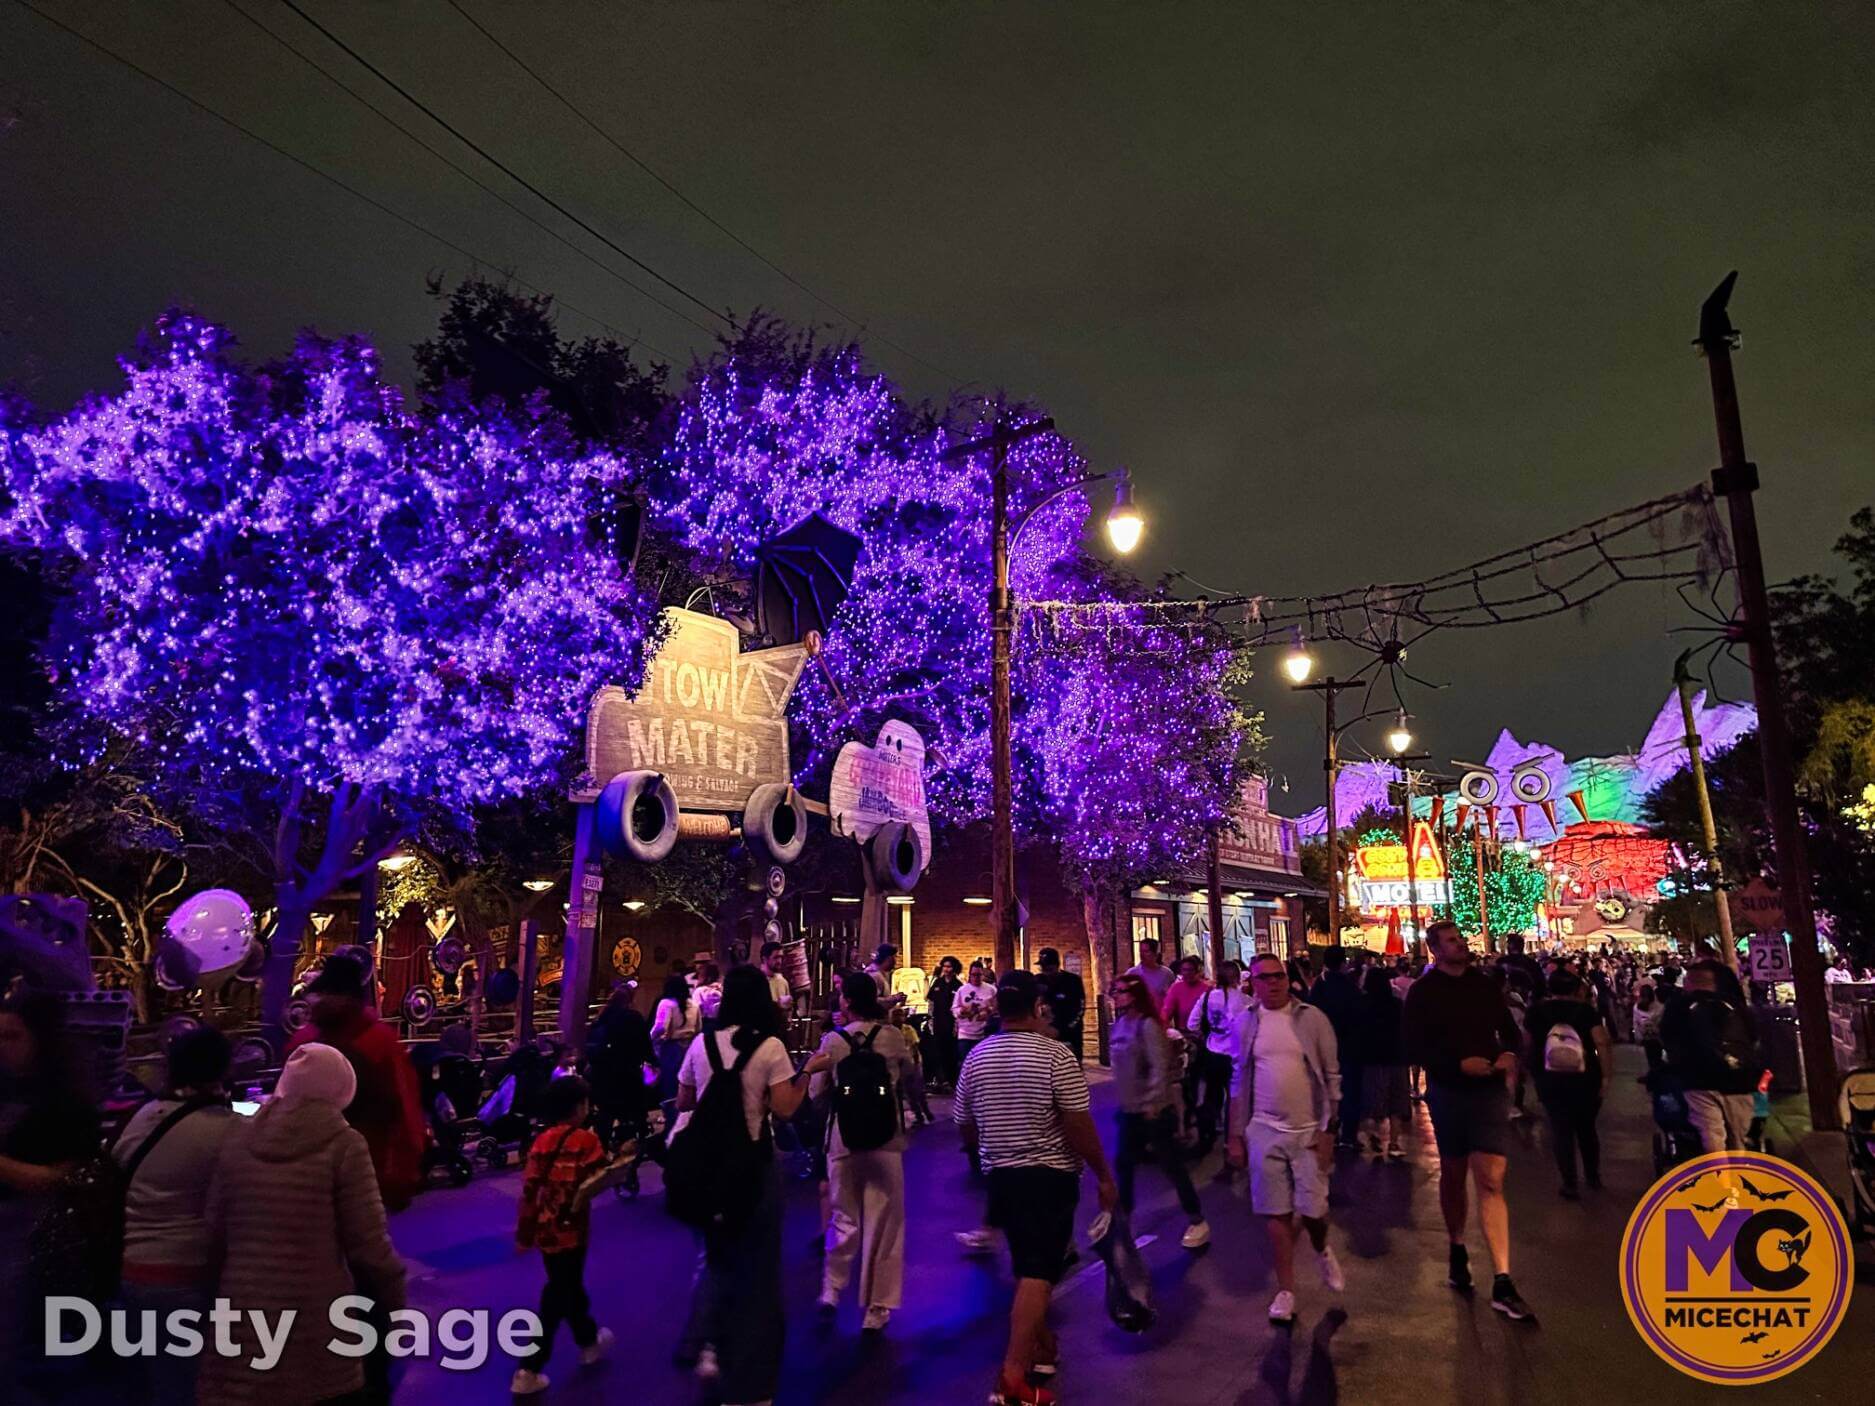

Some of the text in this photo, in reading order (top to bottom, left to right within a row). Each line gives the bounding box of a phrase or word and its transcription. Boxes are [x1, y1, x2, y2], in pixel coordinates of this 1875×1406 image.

[657, 659, 729, 712] TOW
[626, 718, 759, 779] MATER
[1742, 896, 1782, 911] SLOW
[1755, 948, 1784, 970] 25
